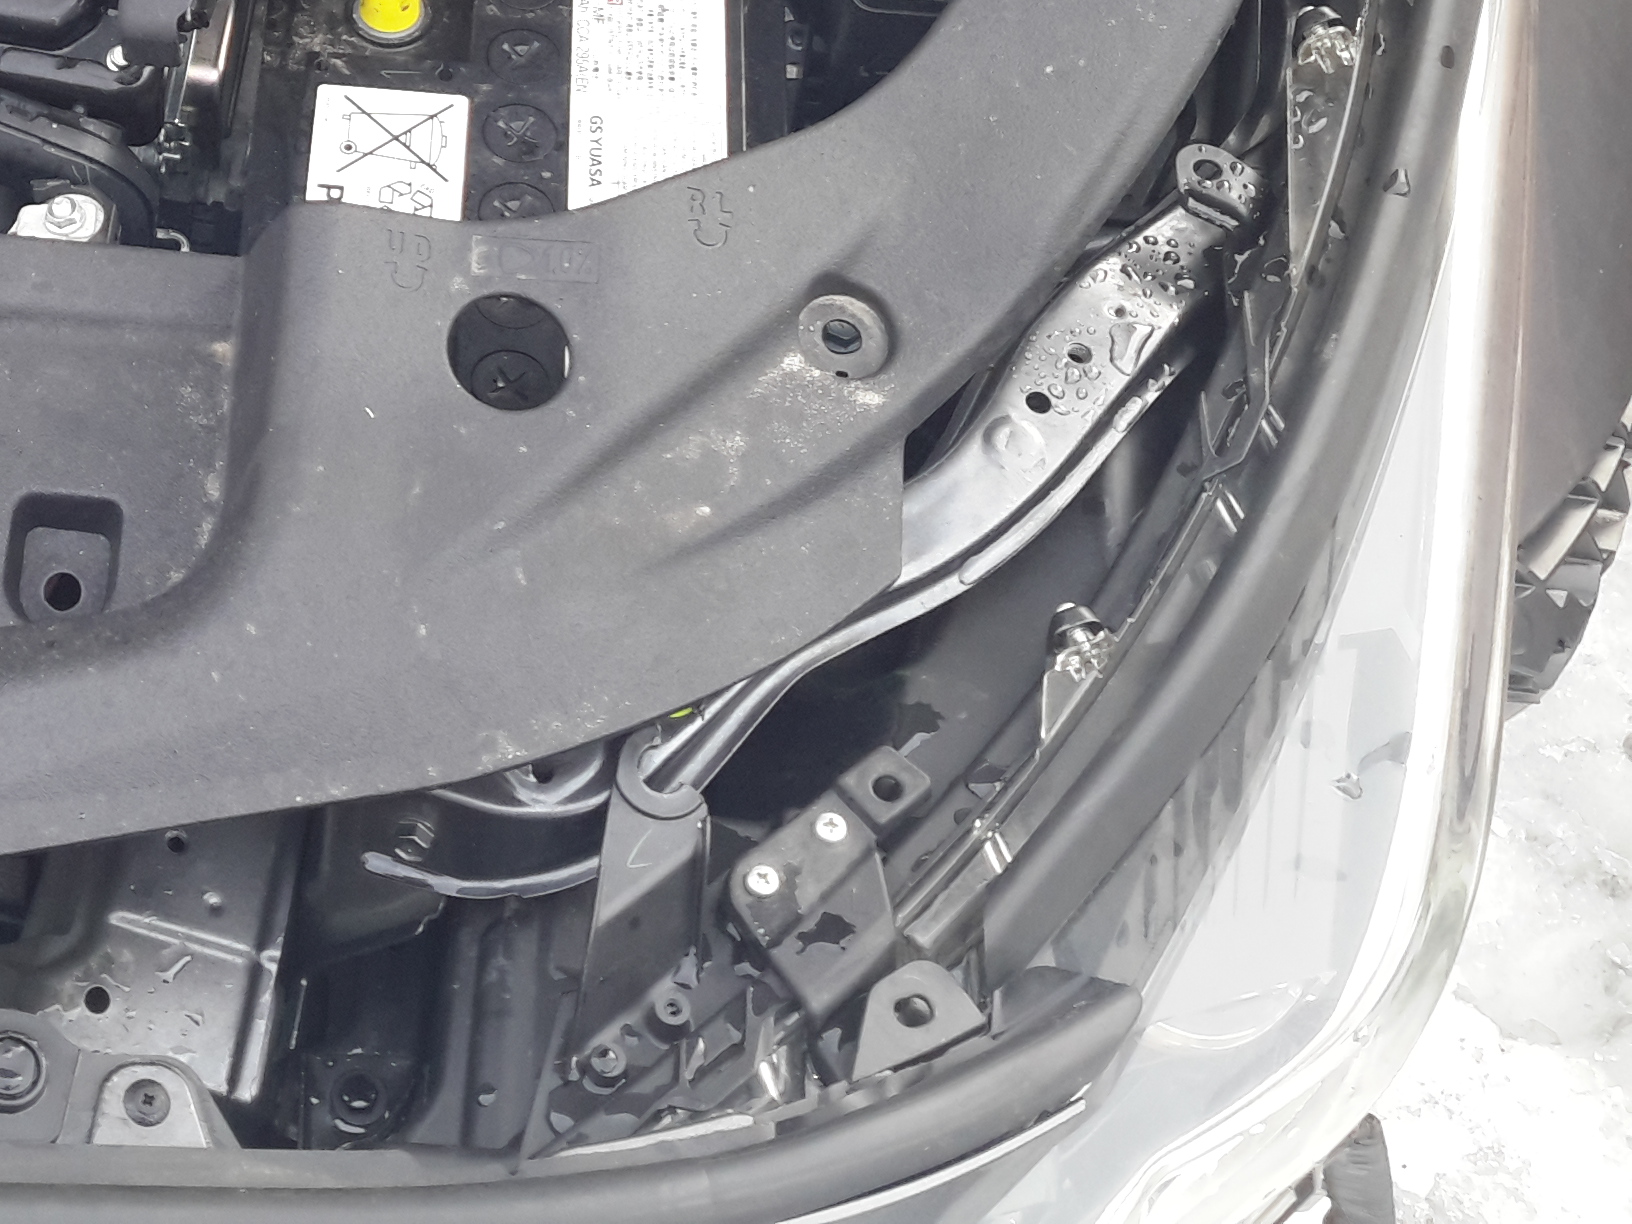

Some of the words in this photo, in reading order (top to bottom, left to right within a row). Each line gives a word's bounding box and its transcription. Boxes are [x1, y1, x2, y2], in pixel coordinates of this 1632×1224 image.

[576, 19, 590, 43] CCA
[589, 115, 604, 134] GS
[588, 137, 603, 187] YUASA
